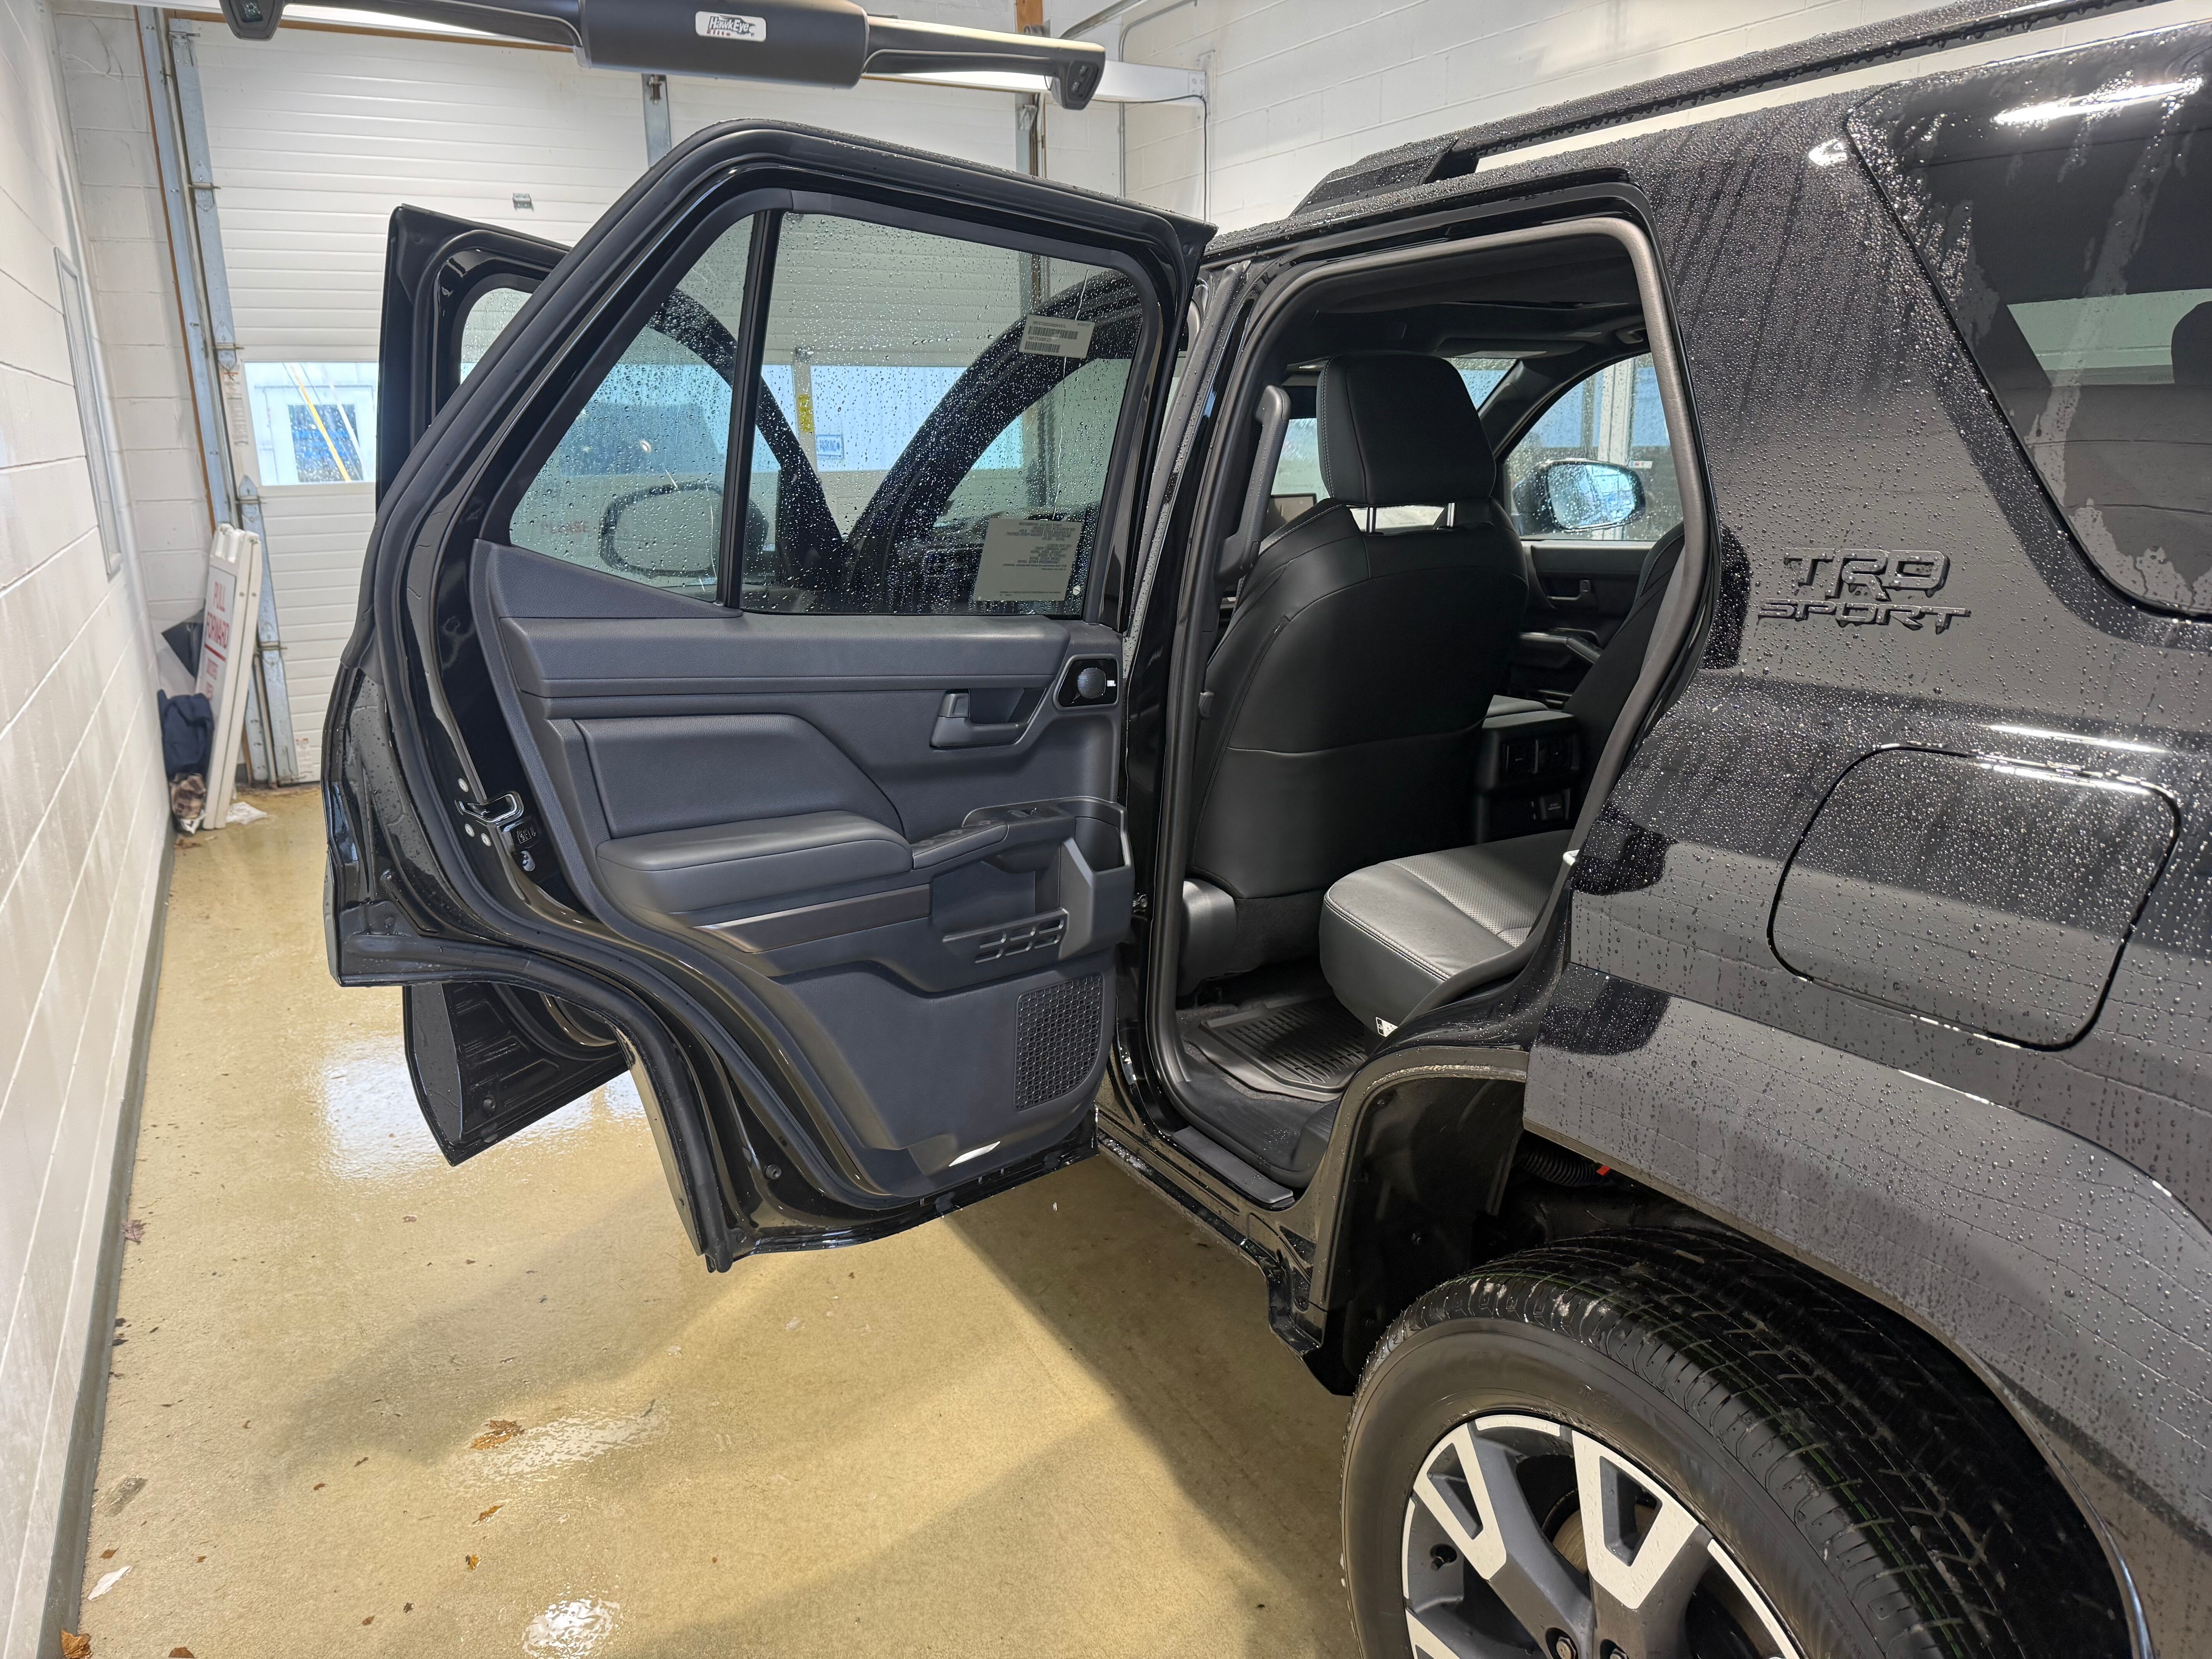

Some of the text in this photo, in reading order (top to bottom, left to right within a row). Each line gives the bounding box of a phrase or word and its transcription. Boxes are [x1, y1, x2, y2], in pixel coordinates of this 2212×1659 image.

[708, 16, 749, 33] HawkEye
[1783, 548, 1951, 601] TRD
[214, 581, 225, 612] PULL
[206, 611, 229, 649] FORWARD
[1758, 598, 1972, 631] SPORT
